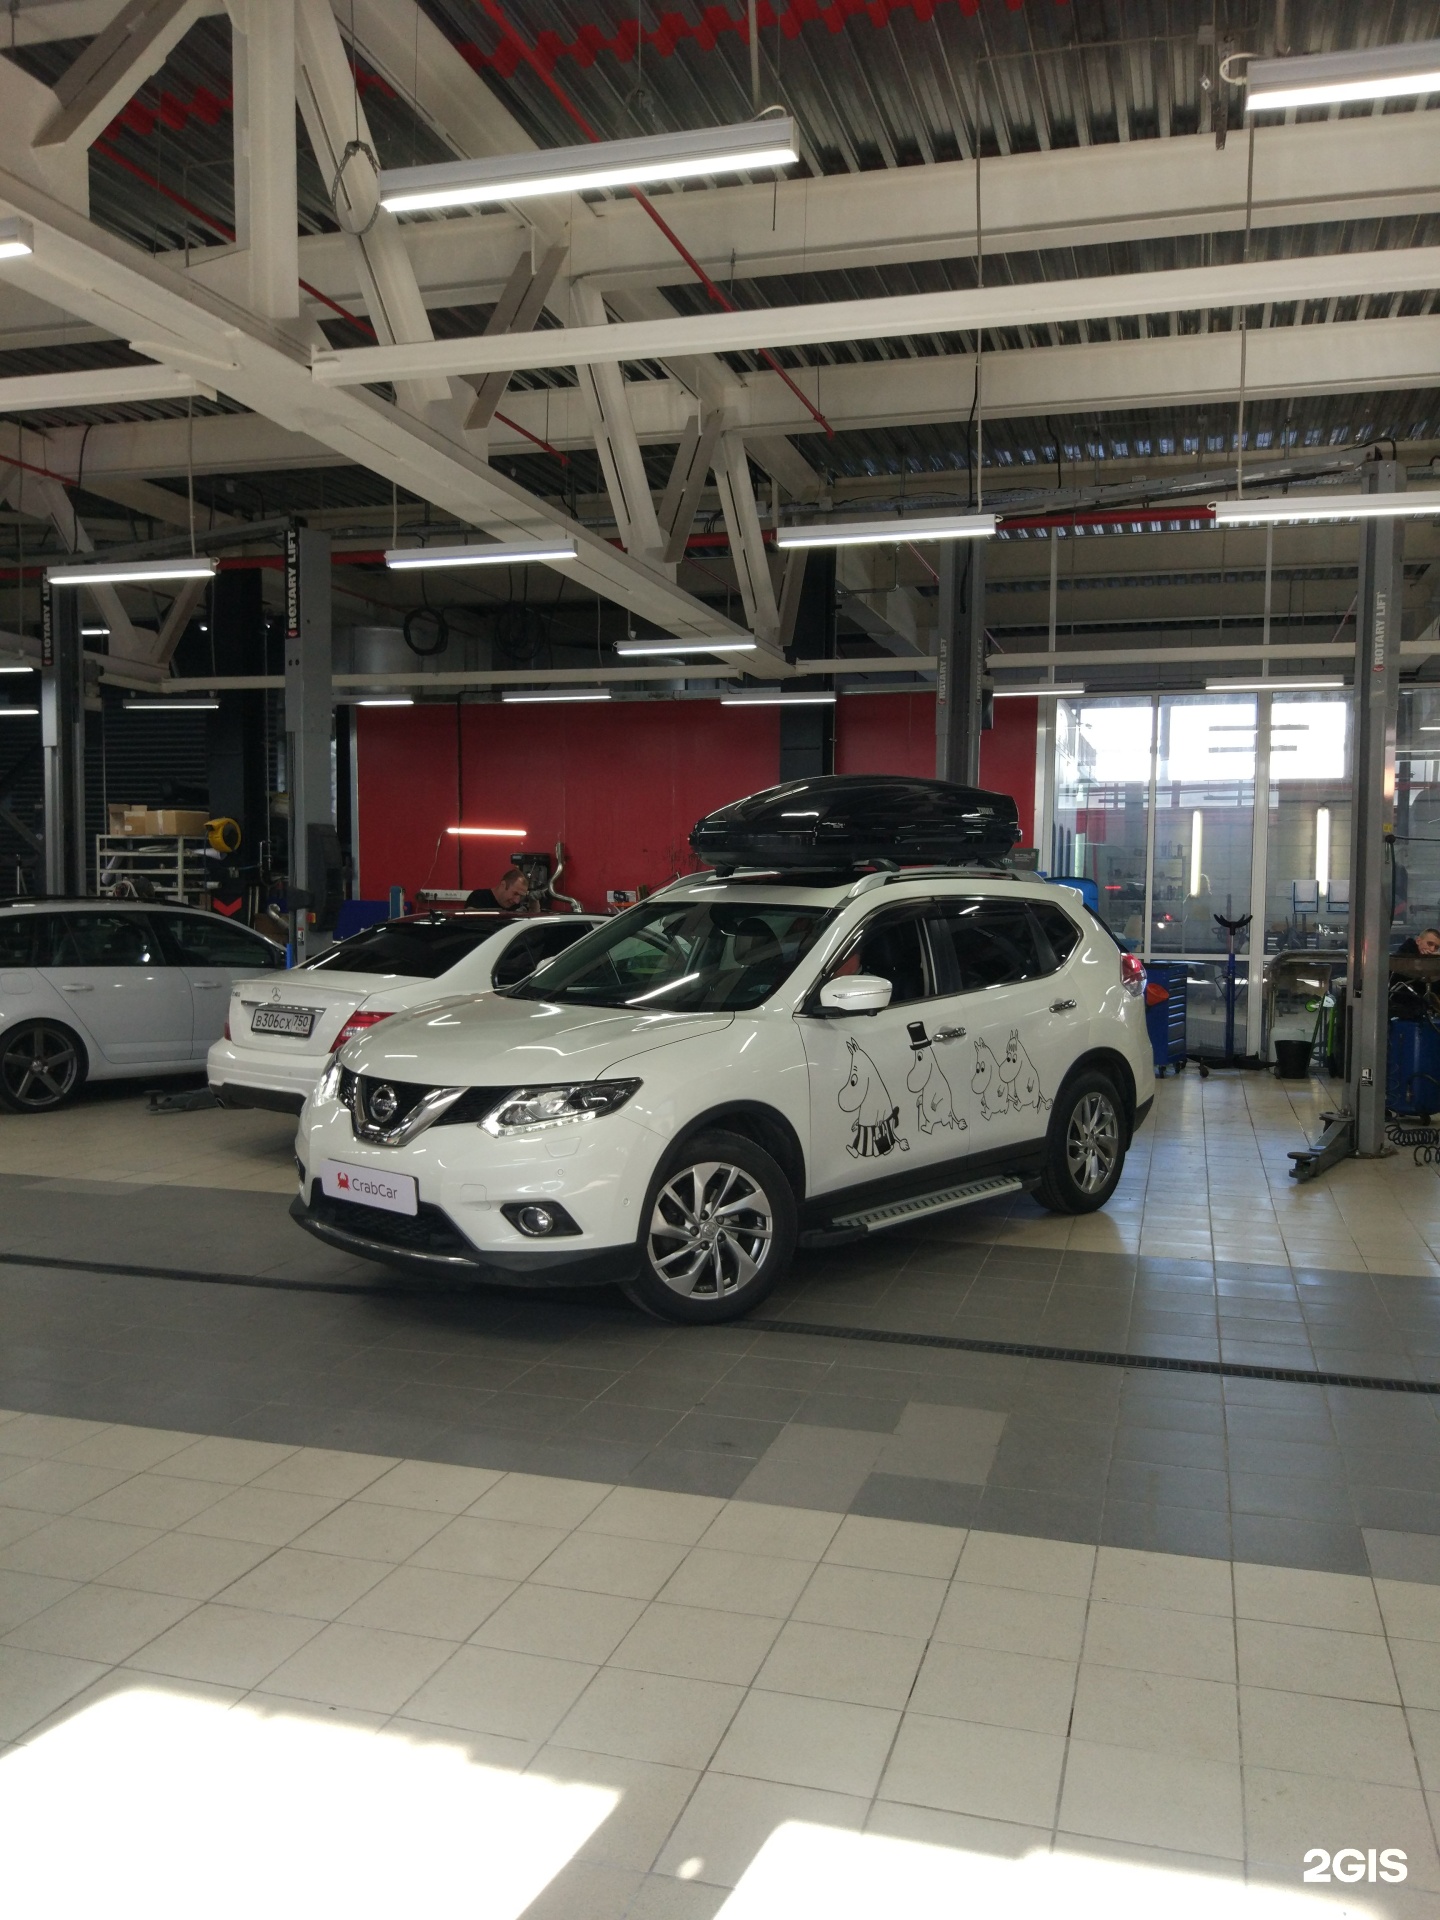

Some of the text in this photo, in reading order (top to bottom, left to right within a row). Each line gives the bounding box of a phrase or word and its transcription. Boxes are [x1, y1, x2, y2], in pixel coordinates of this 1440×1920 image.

[287, 531, 298, 630] ROTARY LIFT
[43, 604, 52, 658] ROTARY
[1375, 594, 1387, 665] ROTARY LIFT
[294, 1015, 310, 1028] 750
[352, 1178, 398, 1200] CrabCar
